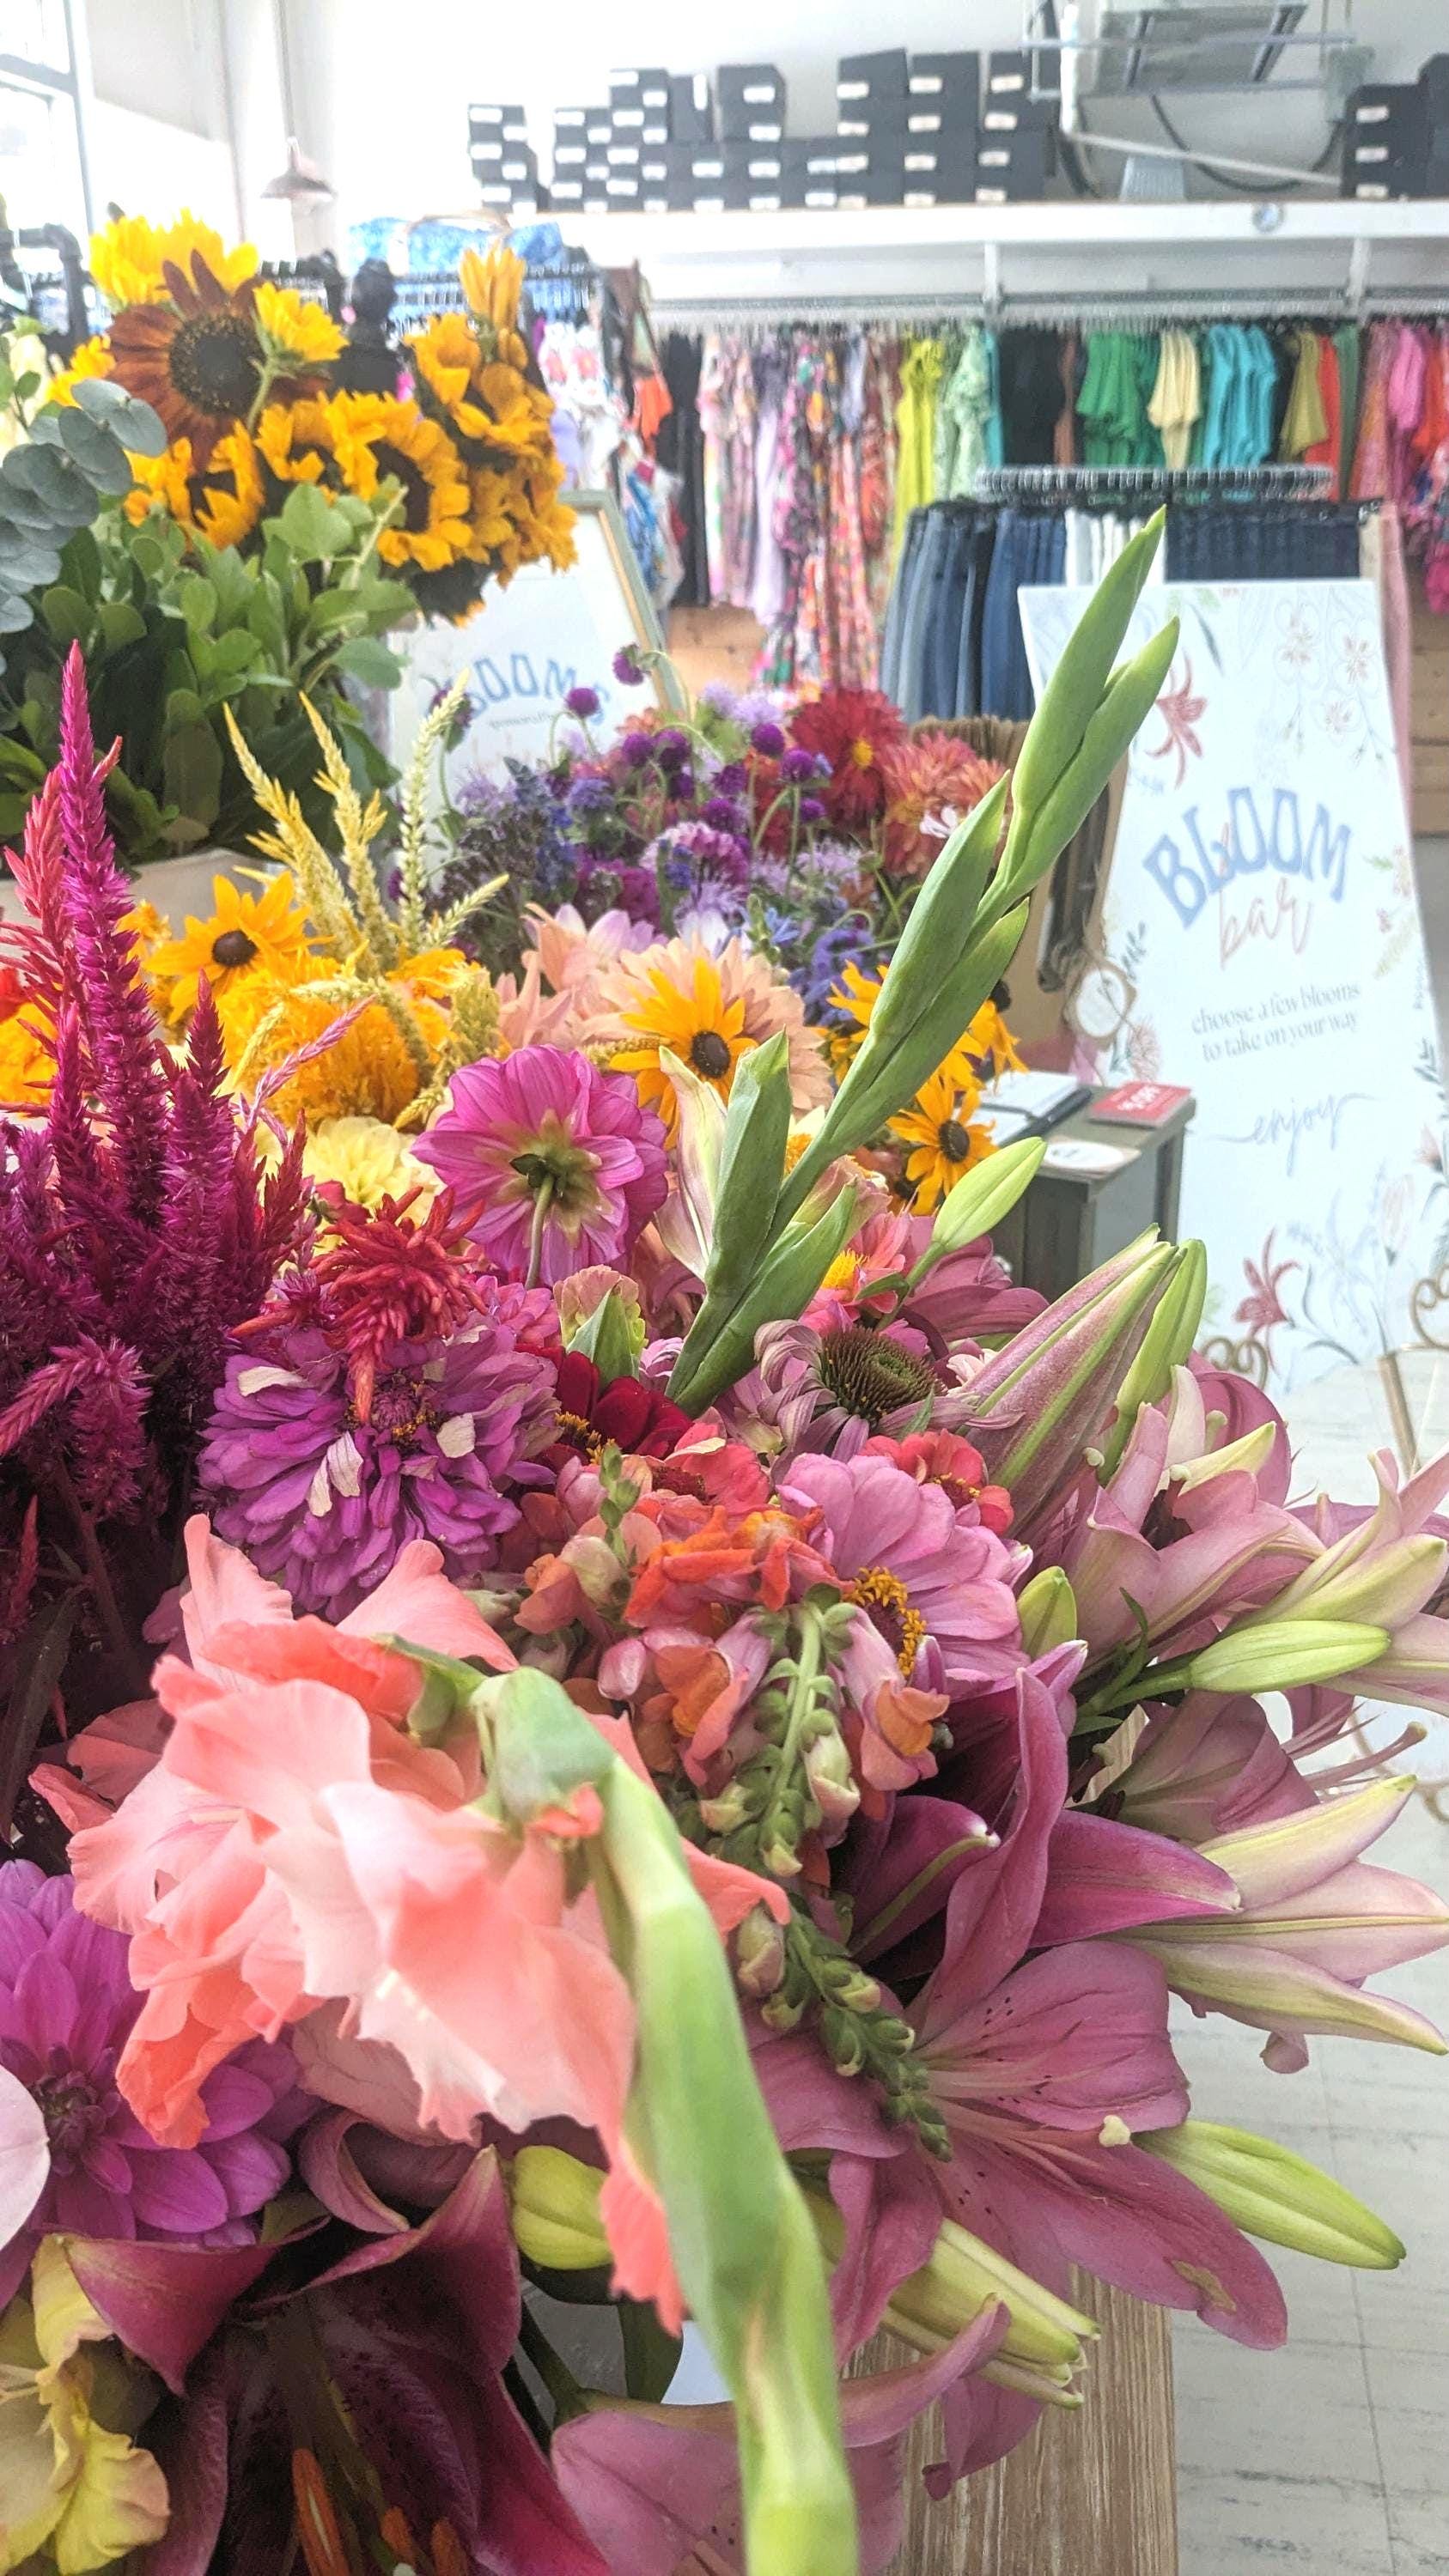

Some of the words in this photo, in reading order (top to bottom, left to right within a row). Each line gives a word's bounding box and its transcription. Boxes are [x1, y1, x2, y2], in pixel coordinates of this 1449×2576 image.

[1142, 787, 1351, 931] BLOOM
[1218, 822, 1312, 971] bar
[1191, 1006, 1253, 1035] choose
[1257, 1002, 1269, 1021] a
[1269, 992, 1299, 1017] few
[1299, 983, 1360, 1010] blooms
[1202, 1041, 1222, 1062] to
[1224, 1028, 1262, 1057] take
[1264, 1026, 1288, 1047] on
[1288, 1017, 1326, 1048] your
[1327, 1010, 1357, 1032] way
[1205, 1092, 1385, 1177] enjoy
